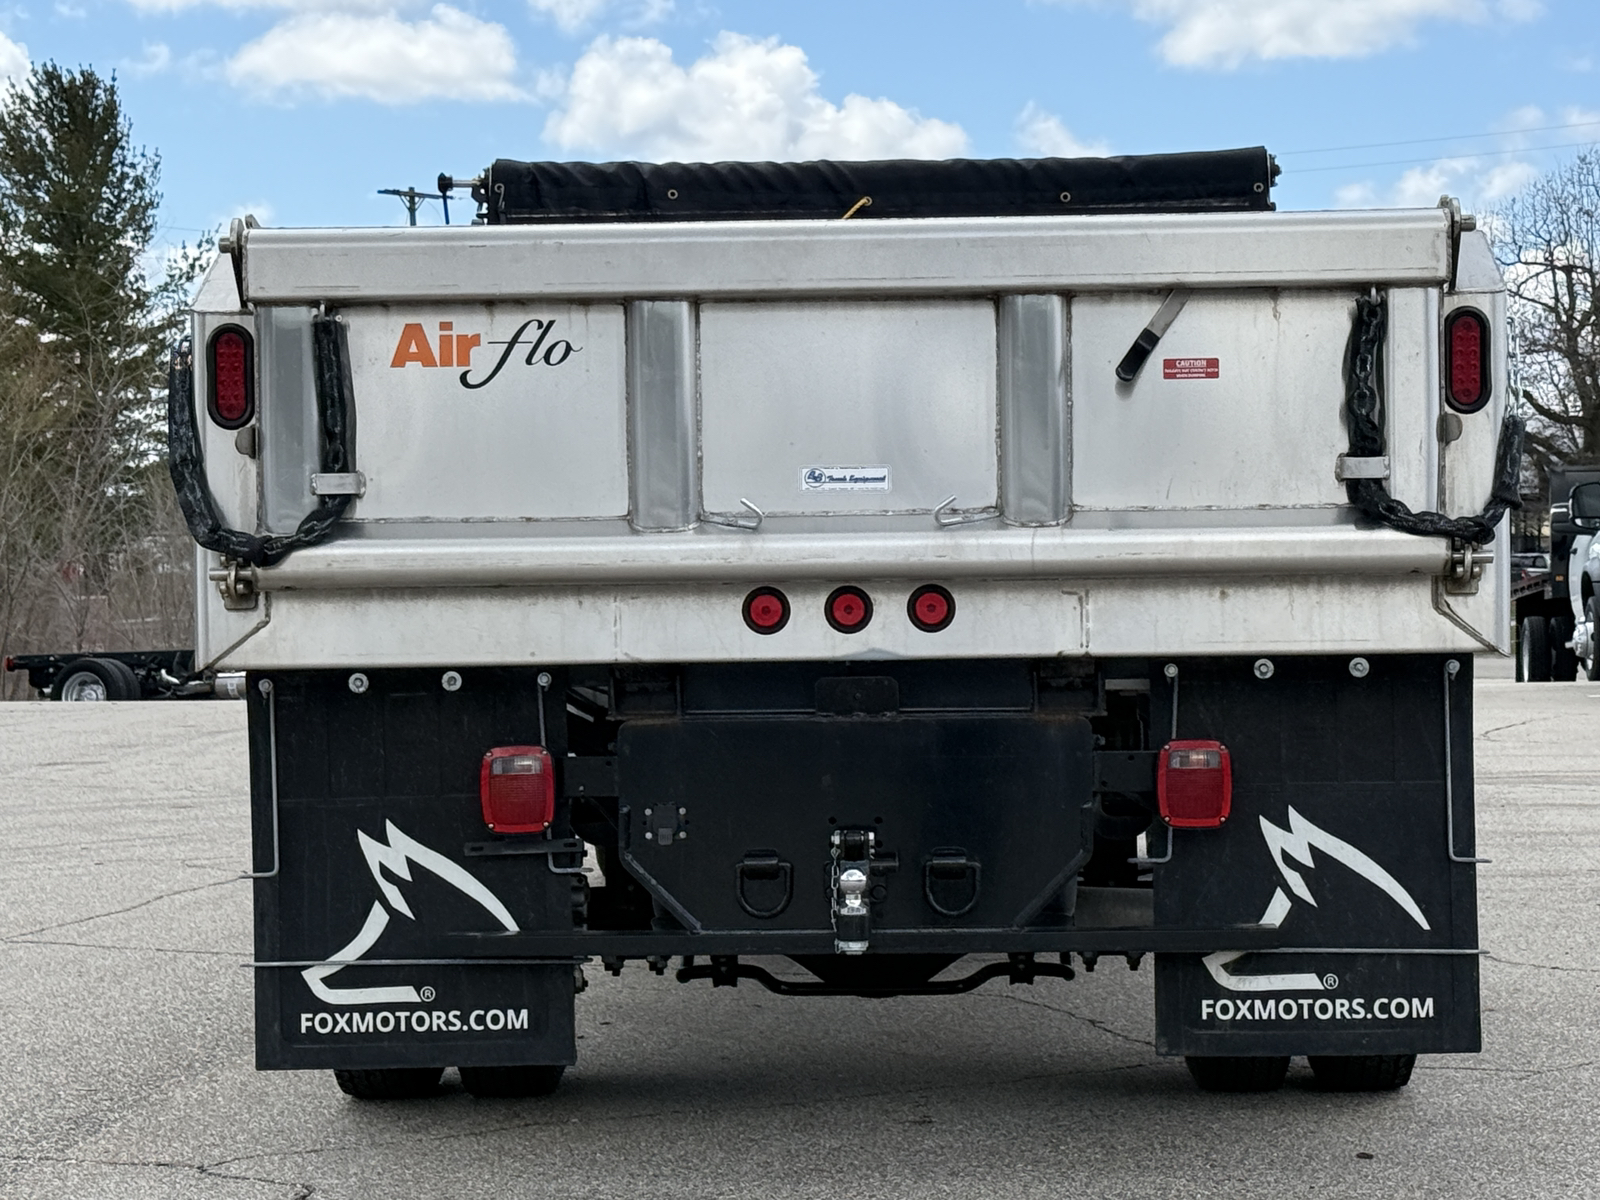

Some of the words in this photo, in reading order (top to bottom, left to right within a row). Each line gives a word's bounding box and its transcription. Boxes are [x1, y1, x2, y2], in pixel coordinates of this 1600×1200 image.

[390, 321, 481, 368] Air
[459, 319, 583, 389] flo
[1175, 360, 1207, 368] CAUTION
[848, 474, 887, 484] Equipment
[1201, 997, 1434, 1020] FOXMOTORS.COM
[300, 1009, 529, 1034] FOXMOTORS.COM
